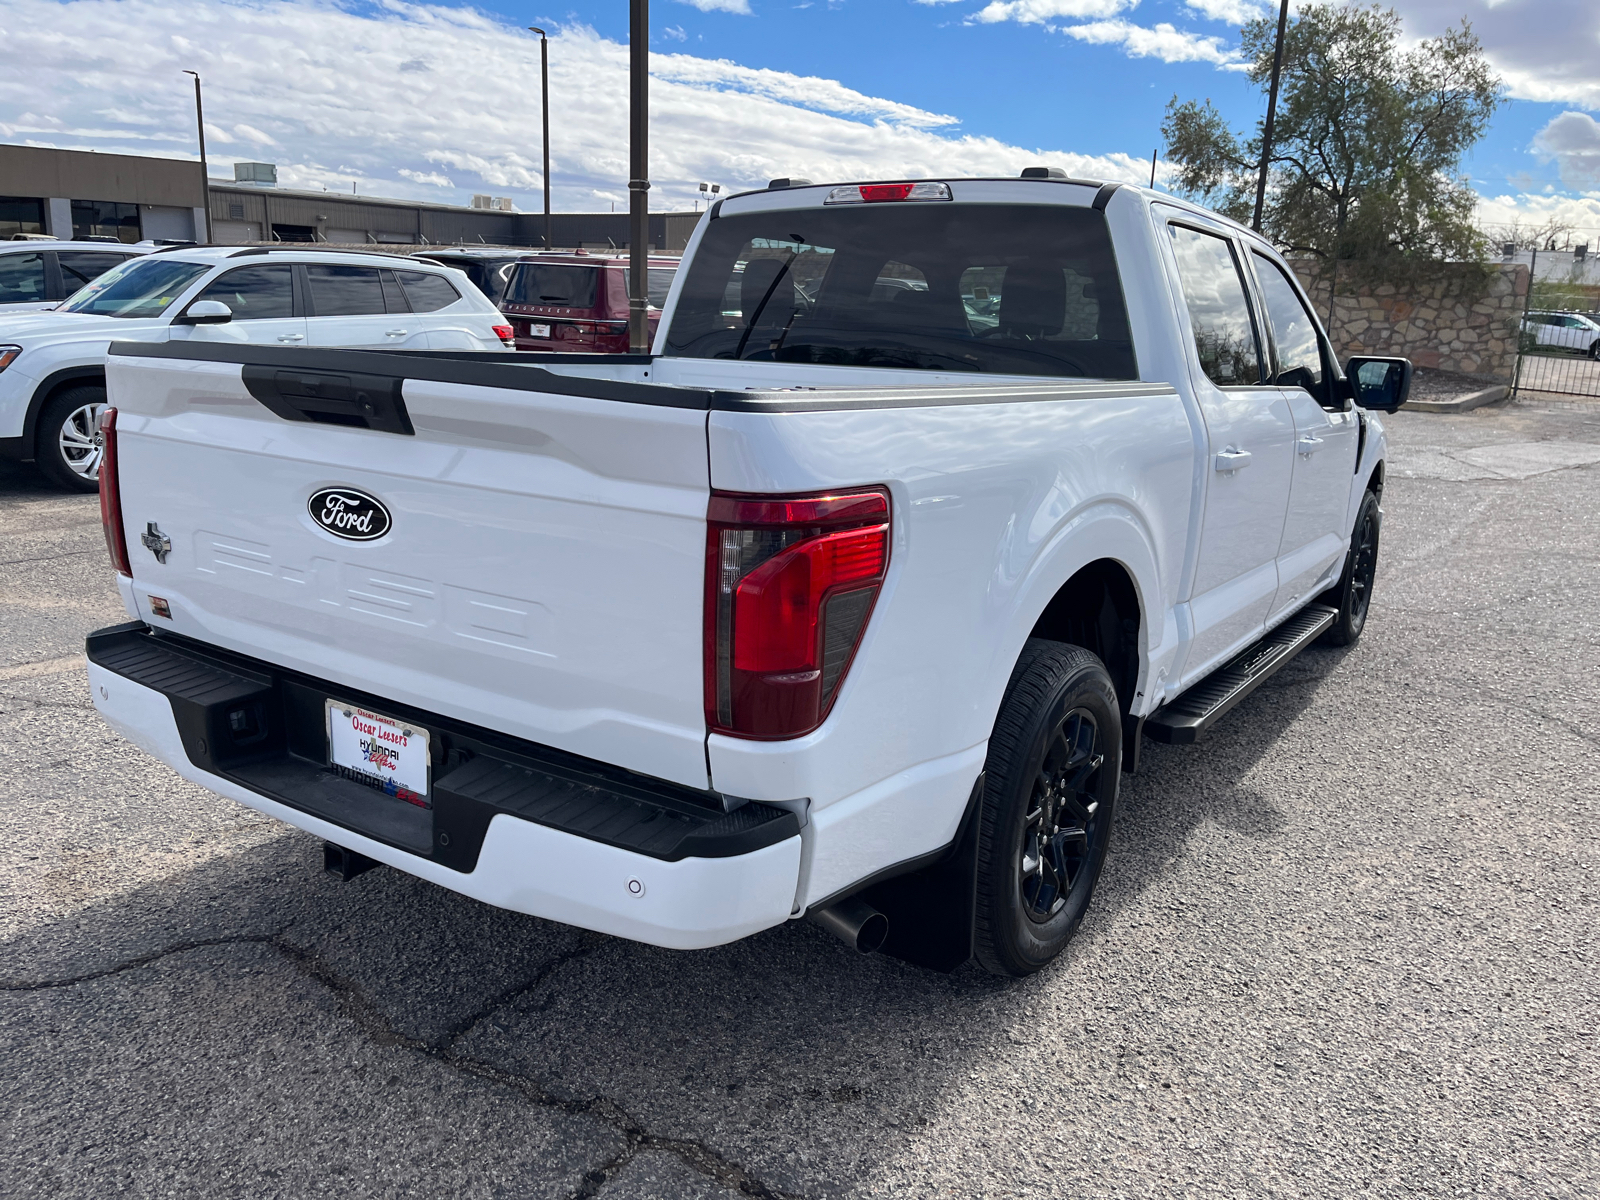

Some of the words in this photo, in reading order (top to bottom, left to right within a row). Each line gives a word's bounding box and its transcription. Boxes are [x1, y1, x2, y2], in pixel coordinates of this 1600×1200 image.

[508, 304, 571, 314] WAGONEER
[321, 494, 373, 533] Ford
[357, 708, 374, 718] Oscar
[375, 714, 395, 726] Leeser's
[352, 716, 376, 736] Oscar
[377, 725, 408, 748] Leeser's
[360, 739, 399, 760] HYUNDAI
[379, 753, 397, 771] Paso
[331, 762, 384, 792] HYUNDAI
